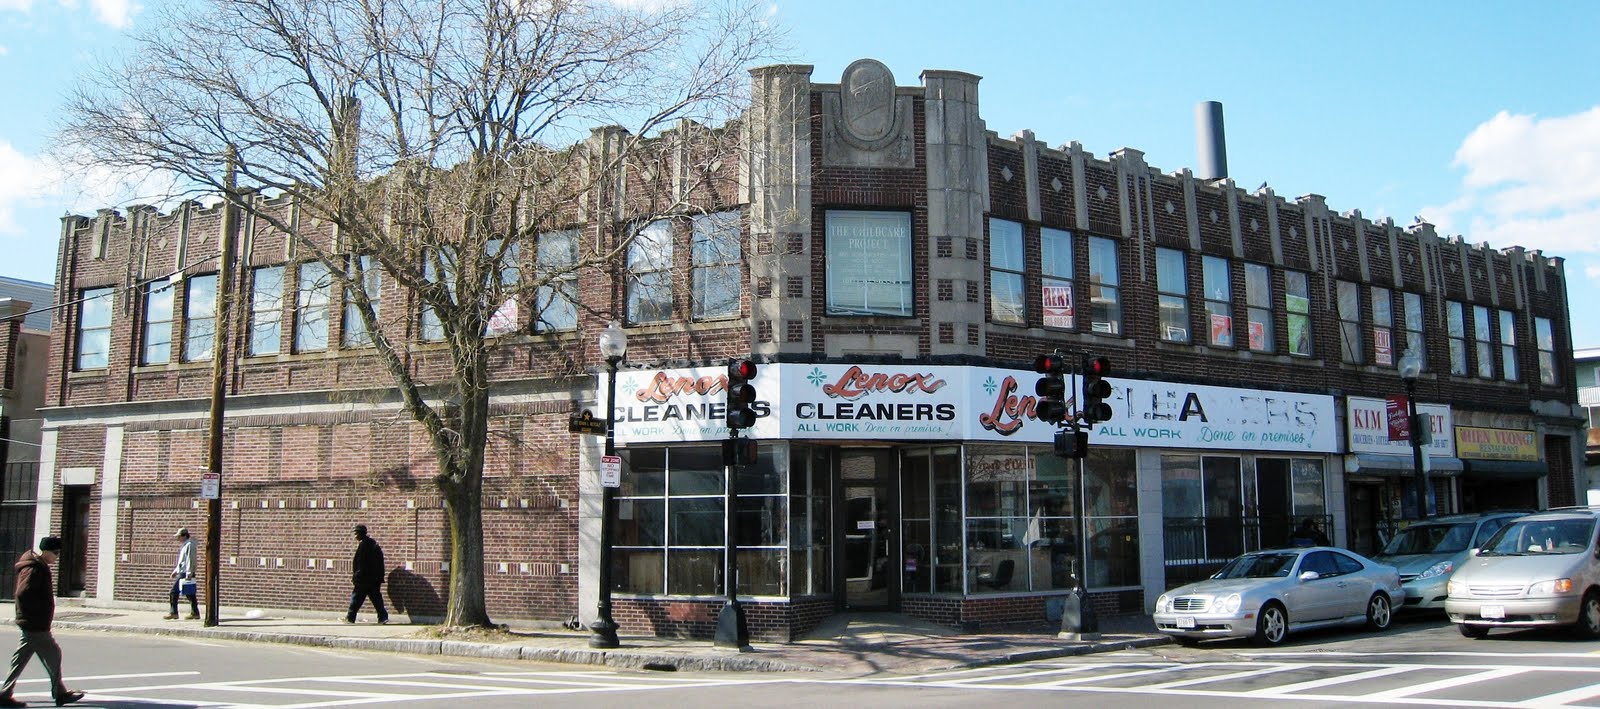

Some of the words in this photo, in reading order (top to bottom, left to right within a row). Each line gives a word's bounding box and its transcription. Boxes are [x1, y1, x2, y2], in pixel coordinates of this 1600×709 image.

[831, 226, 849, 236] THE
[852, 226, 906, 238] CHILDCARE
[849, 239, 889, 250] PROJECT
[1043, 287, 1071, 307] RENT
[823, 365, 947, 402] Lenox
[614, 400, 771, 423] CLEANES
[796, 402, 956, 421] CLEANERS
[1354, 409, 1382, 430] KIM
[632, 427, 665, 436] WORK
[797, 423, 820, 432] ALL
[826, 423, 860, 433] WORK
[864, 421, 887, 433] Done
[1099, 426, 1127, 437] ALL
[1134, 427, 1182, 439] WORK
[1199, 426, 1235, 443] Done
[1241, 431, 1257, 442] on
